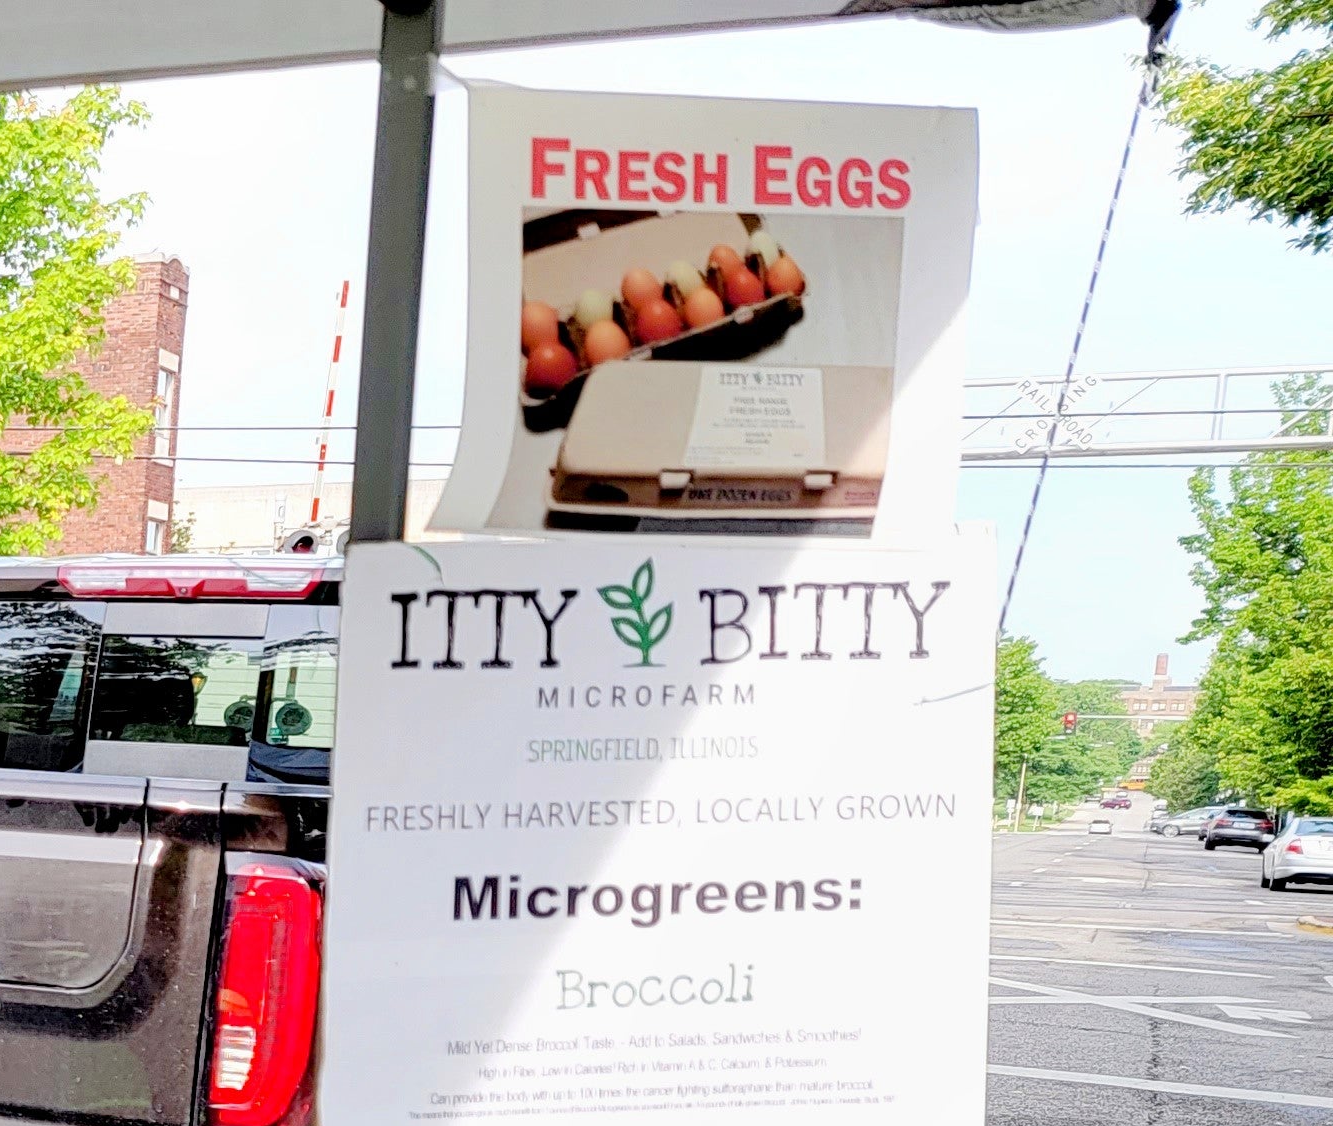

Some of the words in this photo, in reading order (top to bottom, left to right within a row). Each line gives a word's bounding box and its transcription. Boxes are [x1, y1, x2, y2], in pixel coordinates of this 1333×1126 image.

[1018, 380, 1050, 410] RAIL
[390, 588, 578, 670] ITTY
[699, 580, 951, 666] BITTY
[538, 684, 756, 708] MICROFARM
[671, 735, 759, 760] ILLINOIS
[365, 804, 492, 832] FRESHLY
[696, 795, 828, 824] LOCALLY
[835, 792, 956, 821] GROWN
[453, 875, 863, 929] Microgreens:
[555, 963, 756, 1011] Broccoli
